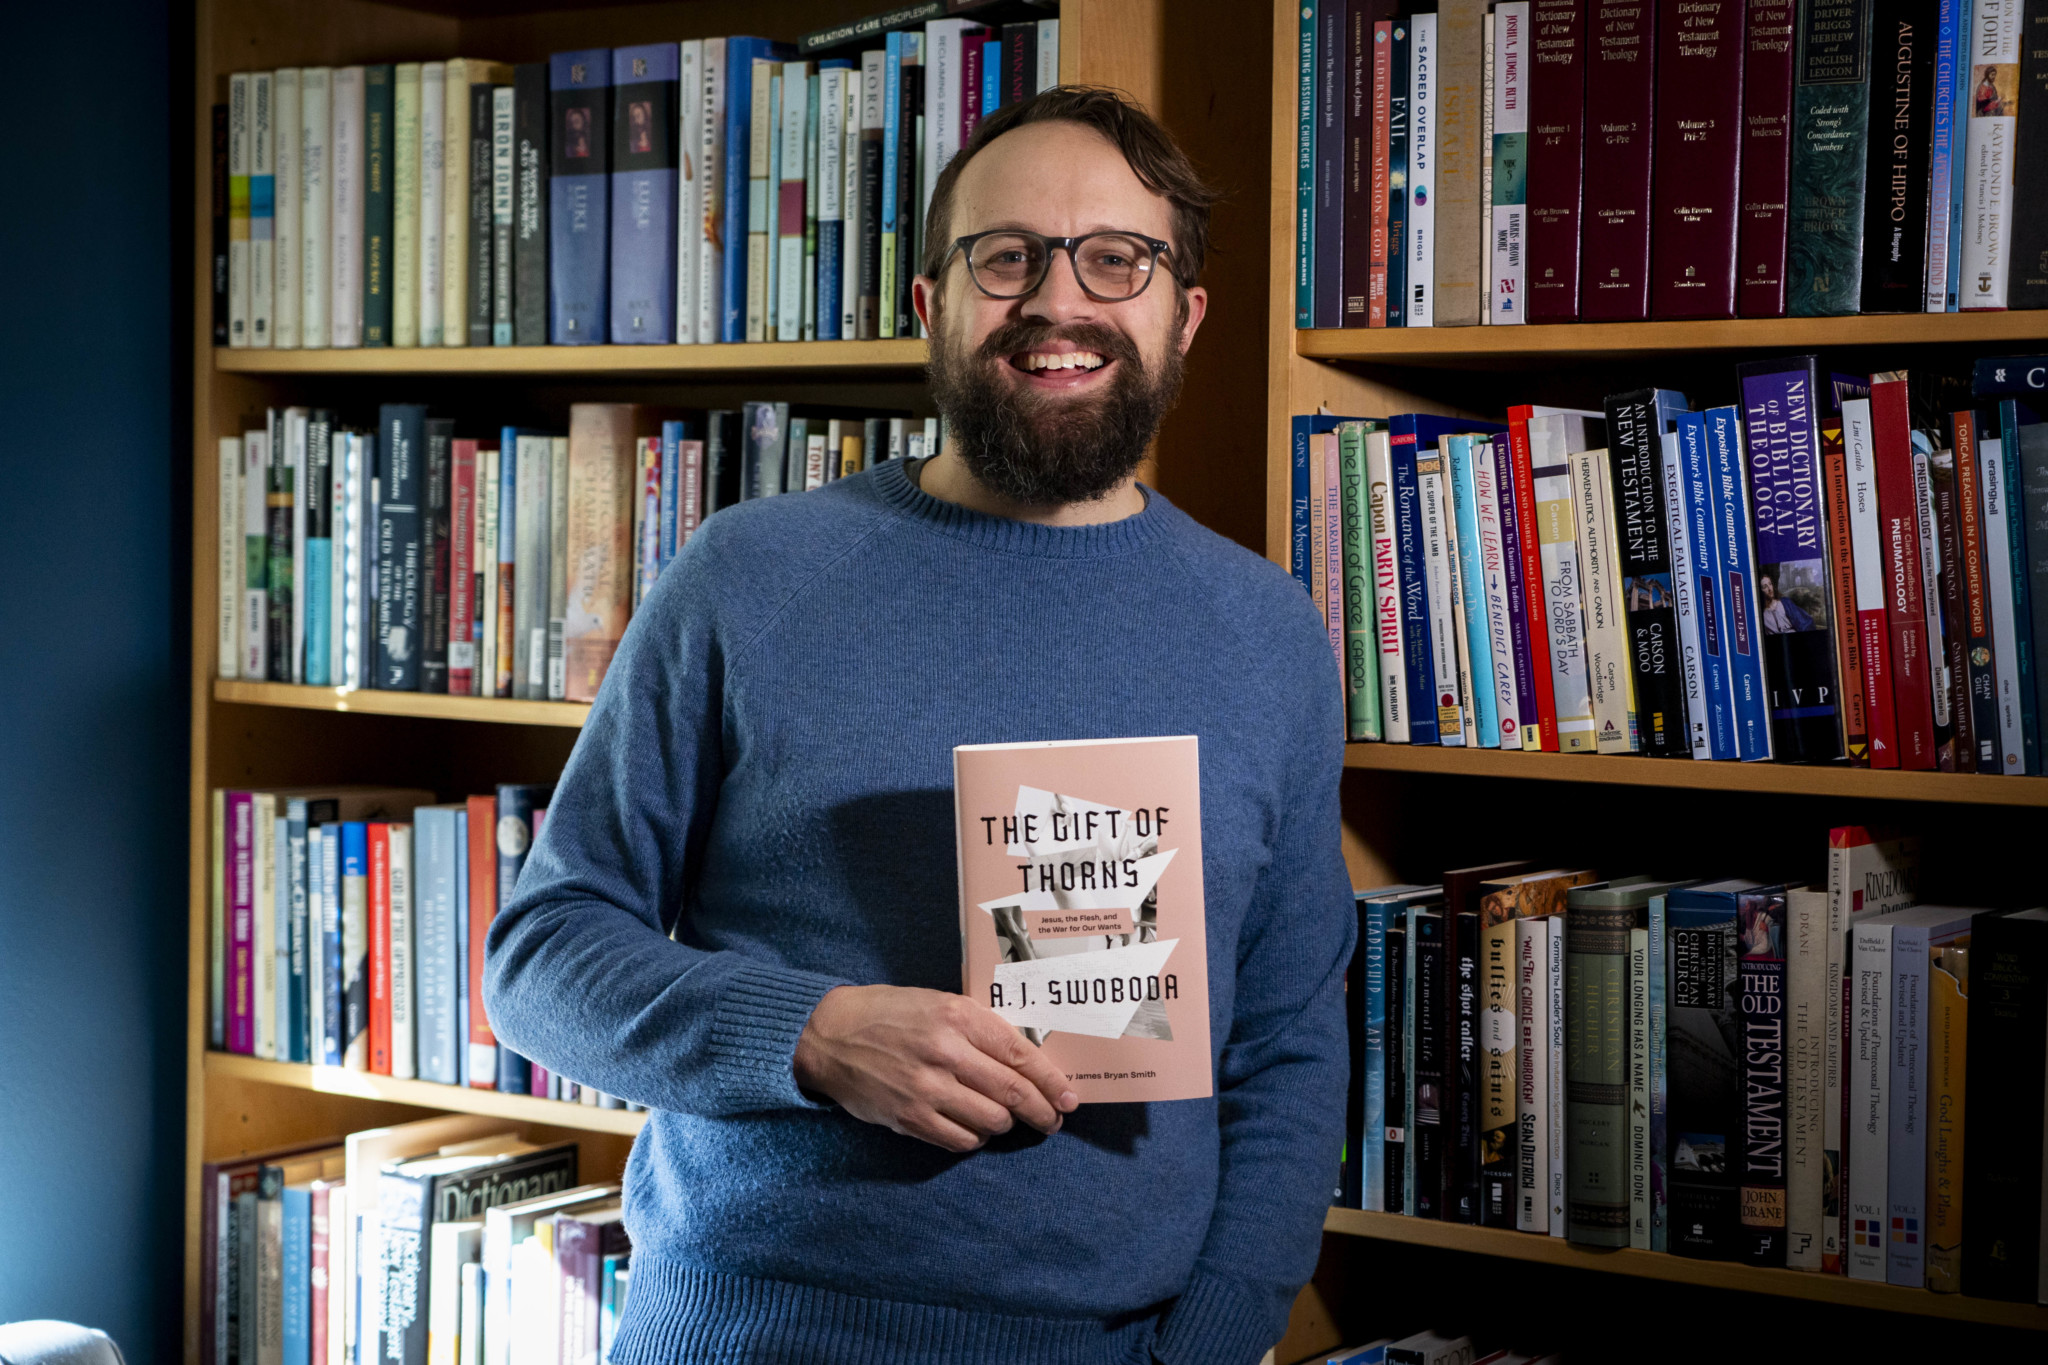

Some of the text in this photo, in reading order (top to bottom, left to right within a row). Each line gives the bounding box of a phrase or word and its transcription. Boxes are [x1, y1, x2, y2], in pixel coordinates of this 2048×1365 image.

[808, 3, 938, 47] CREATION CARE DISCIPLESHIP
[1678, 3, 1721, 14] Dictionary
[1678, 31, 1719, 41] Testament
[1684, 17, 1714, 26] of New
[1981, 15, 1998, 57] JOHN
[1417, 46, 1427, 100] SACRED
[1679, 45, 1717, 57] Theology
[867, 64, 879, 119] BORG
[1301, 32, 1311, 169] STARTING MISSIONAL CHURCHES
[1376, 51, 1385, 122] ELDERSHIP
[1505, 87, 1516, 110] RUTH
[826, 77, 838, 211] The Craft of Research
[1390, 96, 1406, 145] FAIL
[1417, 106, 1426, 170] OVERLAP
[1677, 120, 1714, 129] Volume 3
[1684, 132, 1706, 141] Pri-Z
[1890, 21, 1912, 221] AUGUSTINE OF HIPPO
[496, 113, 510, 209] IRON JOHN
[1374, 157, 1383, 212] MISSION
[1931, 38, 1951, 285] THE CHURCHES THE APOSTLES LEFT BEHIND
[574, 185, 587, 233] LUKE
[638, 180, 650, 229] LUKE
[1374, 216, 1380, 225] OF
[1373, 229, 1382, 256] GOD
[808, 446, 822, 479] TONY
[1616, 405, 1645, 561] NEW TESTAMENT
[1635, 404, 1658, 561] AN INTRODUCTION TO THE
[1748, 404, 1775, 534] THEOLOGY
[1767, 400, 1794, 535] OF BIBLICAL
[1785, 381, 1816, 550] NEW DICTIONARY
[1987, 459, 1999, 515] erasinghell
[1477, 470, 1498, 571] HOW WE LEARN
[1856, 482, 1867, 513] Hosea
[1344, 436, 1365, 624] The Parables of Grace
[1398, 464, 1423, 620] The Romance of the Word
[1666, 464, 1690, 616] EXEGETICAL FALLACIES
[1958, 424, 1983, 633] TOPICAL PREACHING IN A COMPLEX WORLD
[1370, 482, 1399, 656] Capon PARTY SPIRIT
[1890, 518, 1907, 613] PNEUMATOLOGY
[1550, 579, 1569, 676] TO LORD'S DAY
[1559, 560, 1578, 657] FROM SABBATH
[1352, 639, 1365, 689] CAPON
[1490, 595, 1512, 705] BENEDICT CAREY
[1637, 629, 1650, 672] & MOO
[1649, 623, 1664, 674] CARSON
[1685, 646, 1698, 700] CARSON
[980, 807, 1170, 845] THE GIFT OF
[1017, 859, 1139, 893] THORNS
[1041, 916, 1064, 924] Jesus,
[1079, 914, 1101, 923] Flesh,
[1103, 913, 1117, 921] and
[1048, 974, 1178, 1004] SWOBODA
[1634, 949, 1645, 976] YOUR
[1677, 932, 1689, 1005] CHURCH
[1689, 933, 1699, 1005] CHRISTIAN
[1706, 933, 1716, 1007] DICTIONARY
[1742, 975, 1780, 993] THE
[1459, 957, 1474, 1061] the shot caller
[1489, 938, 1505, 1117] bullies and saints
[1521, 936, 1535, 1104] WILL THE CIRCLE BE UNBROKEN?
[1634, 980, 1644, 1026] LONGING
[1741, 995, 1781, 1014] OLD
[1827, 963, 1839, 1087] KINGDOMS AND EMPIRES
[1634, 1029, 1644, 1050] HAS
[1104, 1072, 1128, 1081] Bryan
[1634, 1062, 1644, 1092] NAME
[1747, 1019, 1781, 1177] TESTAMENT
[1522, 1113, 1536, 1189] SEAN DIETRICH
[1634, 1126, 1644, 1203] DOMINIC DONE
[1936, 1094, 1952, 1227] God Laughs & Plays
[1743, 1206, 1783, 1219] DRANE
[1746, 1190, 1777, 1203] JOHN
